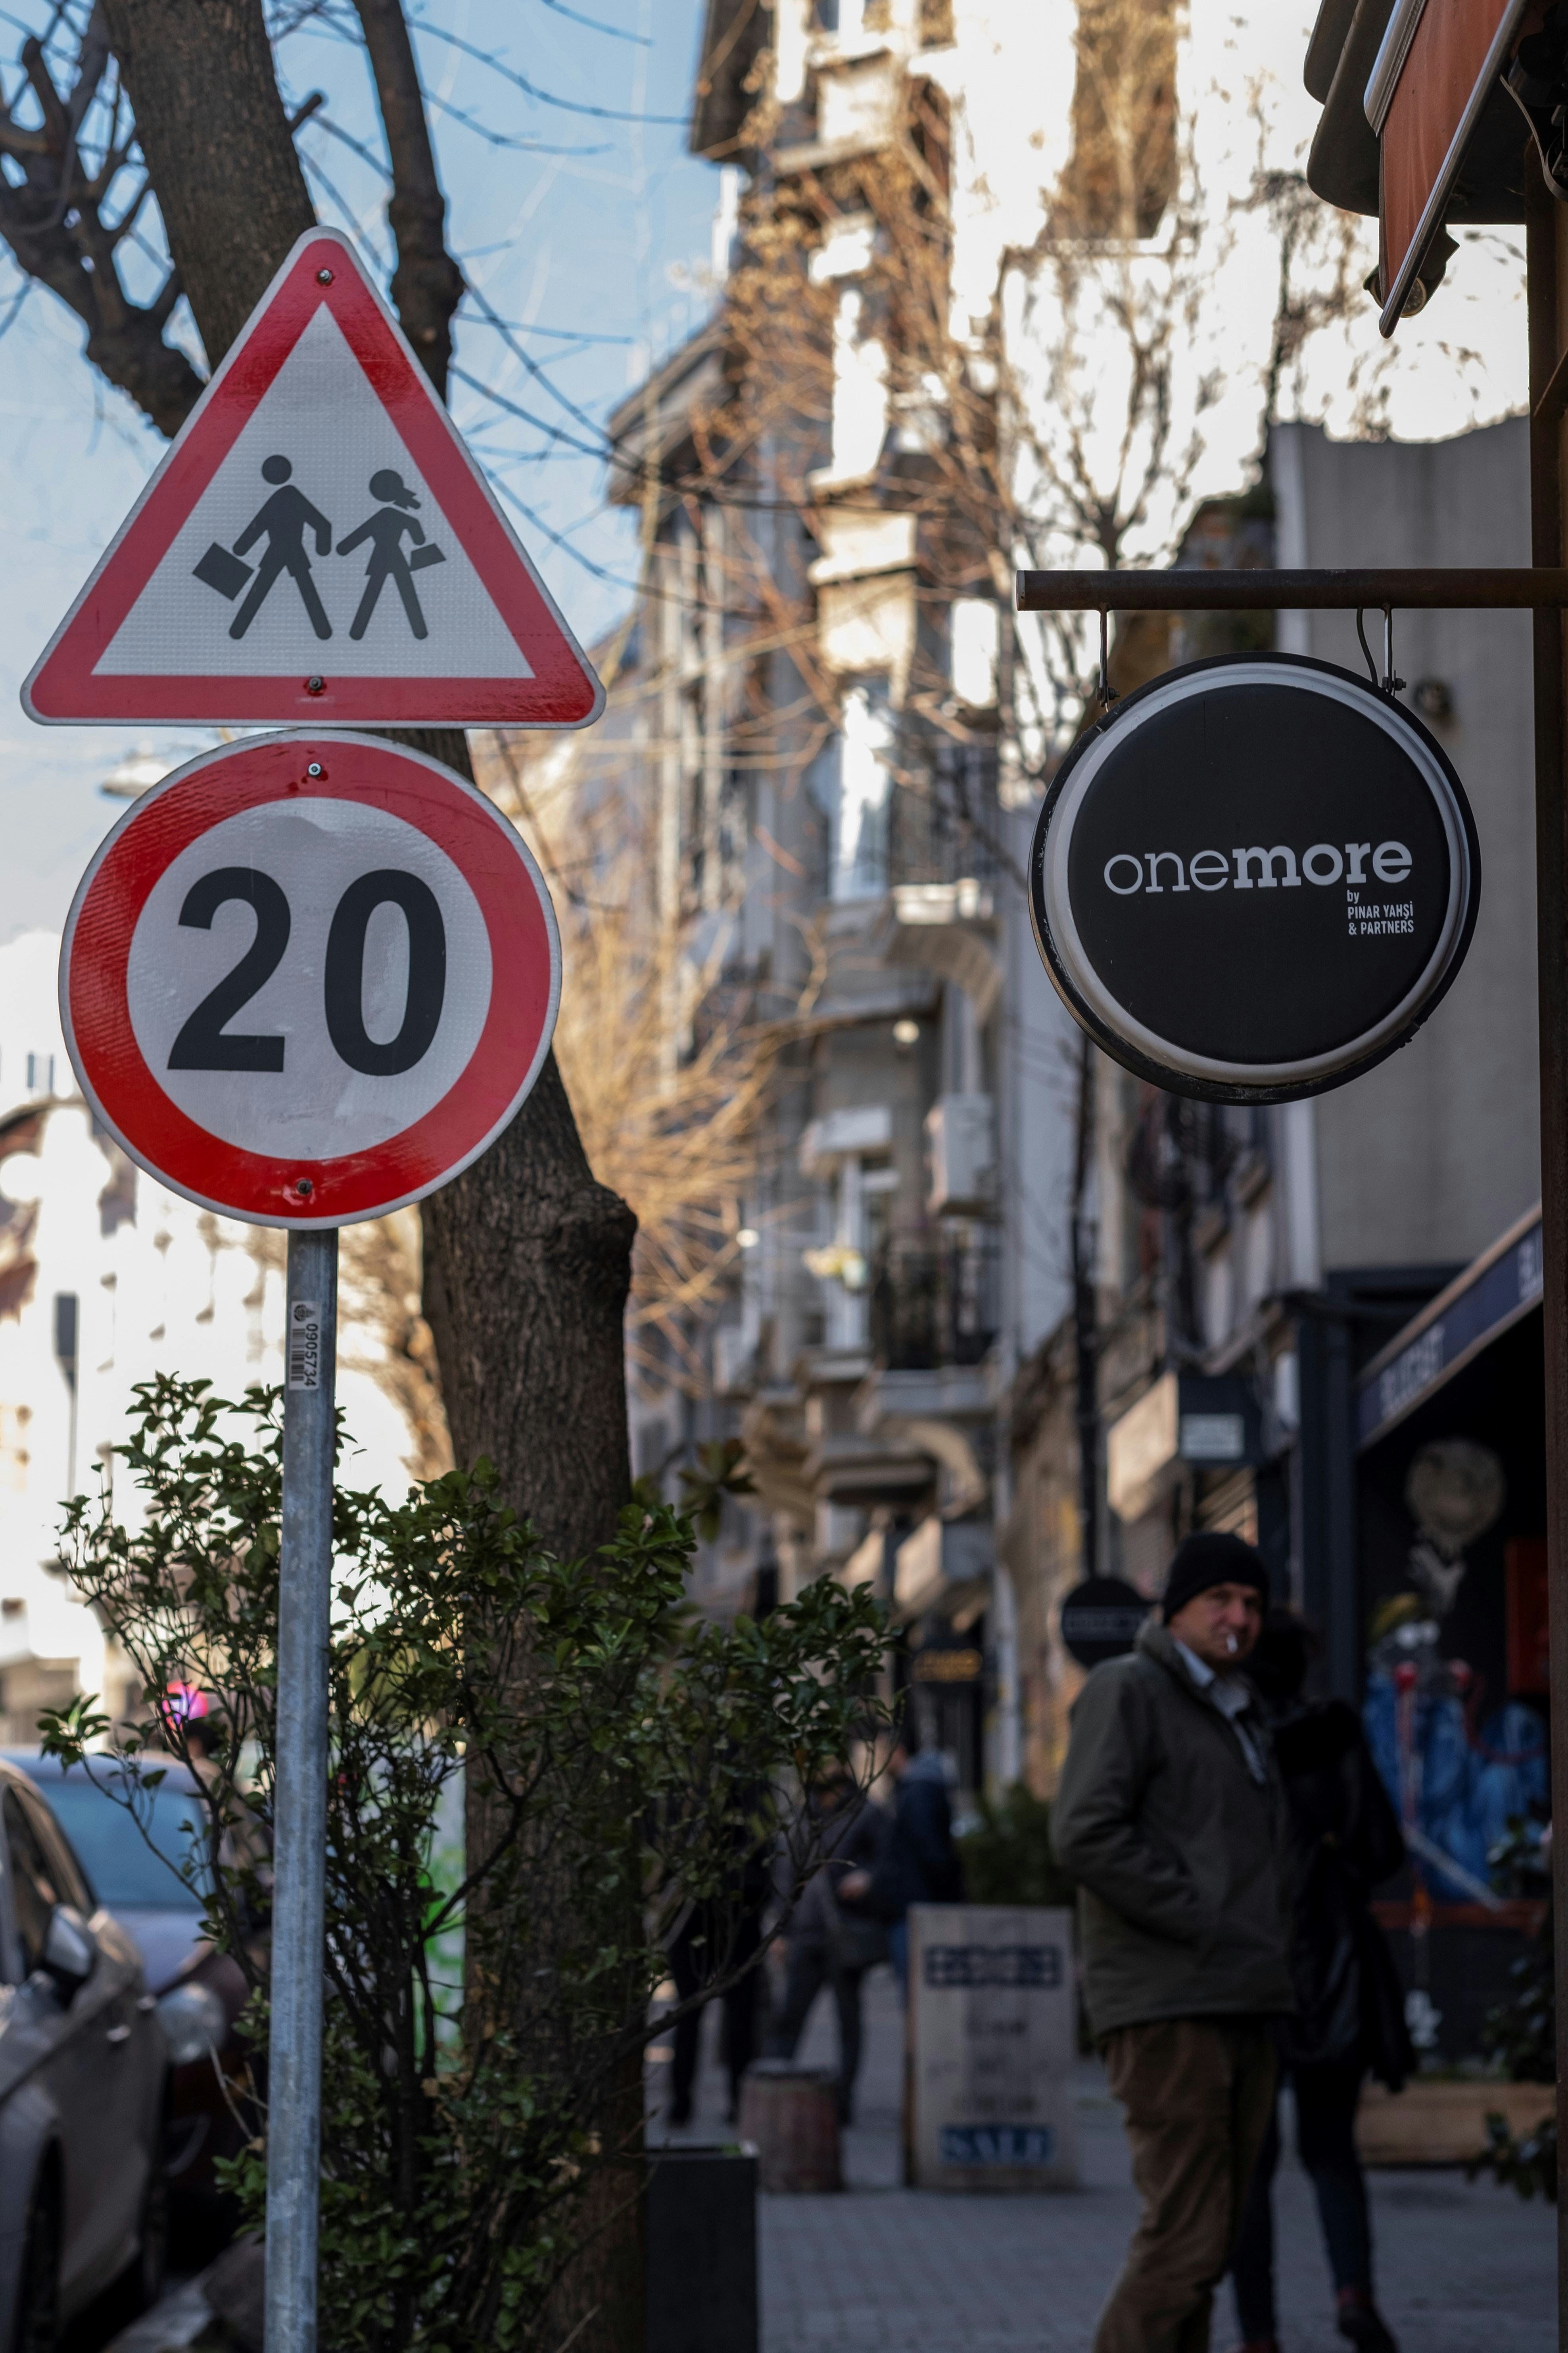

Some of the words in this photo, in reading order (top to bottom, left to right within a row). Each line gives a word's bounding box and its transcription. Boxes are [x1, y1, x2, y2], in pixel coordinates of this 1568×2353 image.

[1104, 840, 1413, 895] onemore
[1347, 889, 1360, 904] by
[1347, 905, 1380, 919] PINAR
[1383, 901, 1413, 920] YAHŞİ
[1348, 922, 1357, 935] &
[1361, 920, 1414, 935] PARTNERS
[167, 866, 446, 1076] 20
[304, 1323, 319, 1386] 0905734
